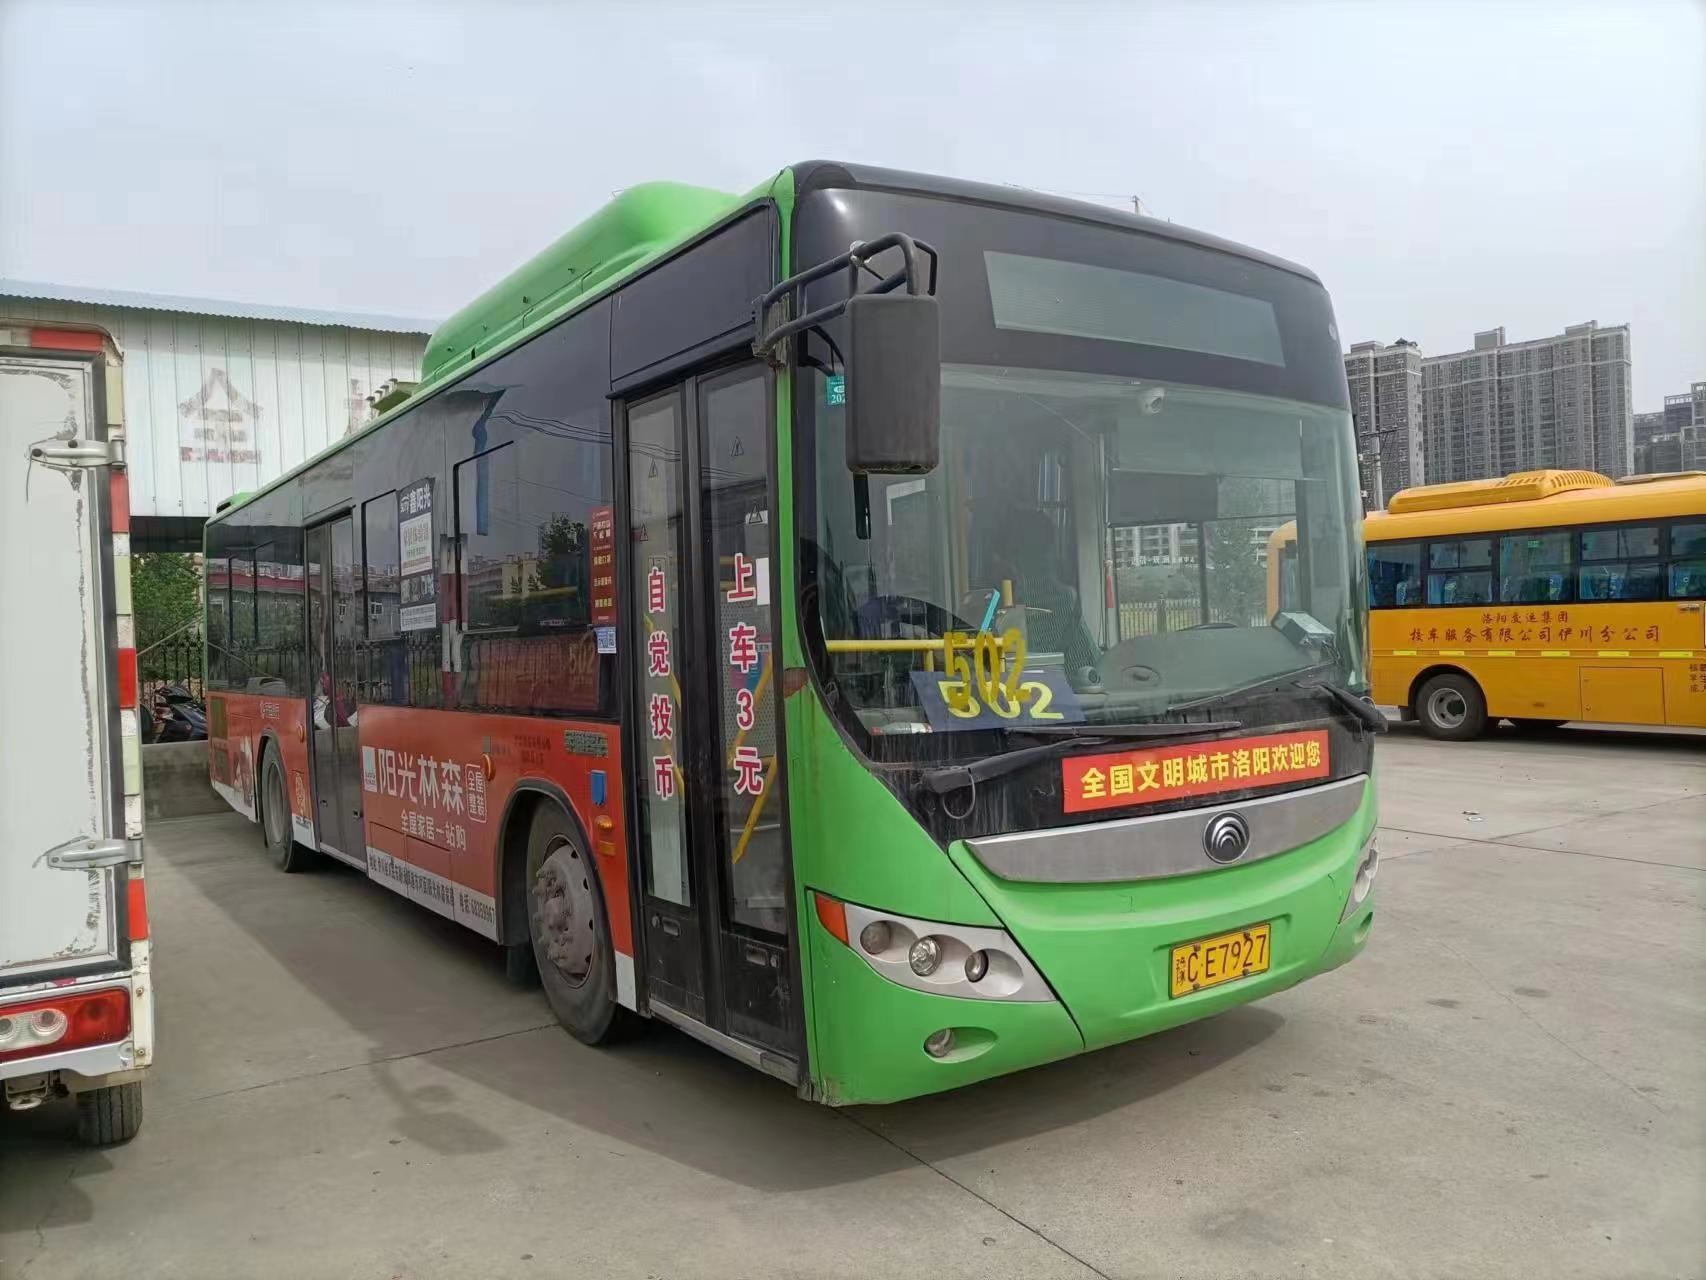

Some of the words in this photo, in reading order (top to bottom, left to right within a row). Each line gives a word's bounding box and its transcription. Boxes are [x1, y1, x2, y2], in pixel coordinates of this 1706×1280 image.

[1409, 625, 1660, 643] 校车服务有限公司伊川分公司
[1482, 610, 1569, 624] 洛阳交运集团
[648, 566, 674, 799] 自觉投币
[727, 553, 764, 795] 上车3元
[944, 628, 1031, 709] 502
[377, 748, 465, 816] 阳光林森
[1081, 740, 1321, 799] 全国文明城市洛阳欢迎您
[400, 808, 466, 851] 全屋家居一站购
